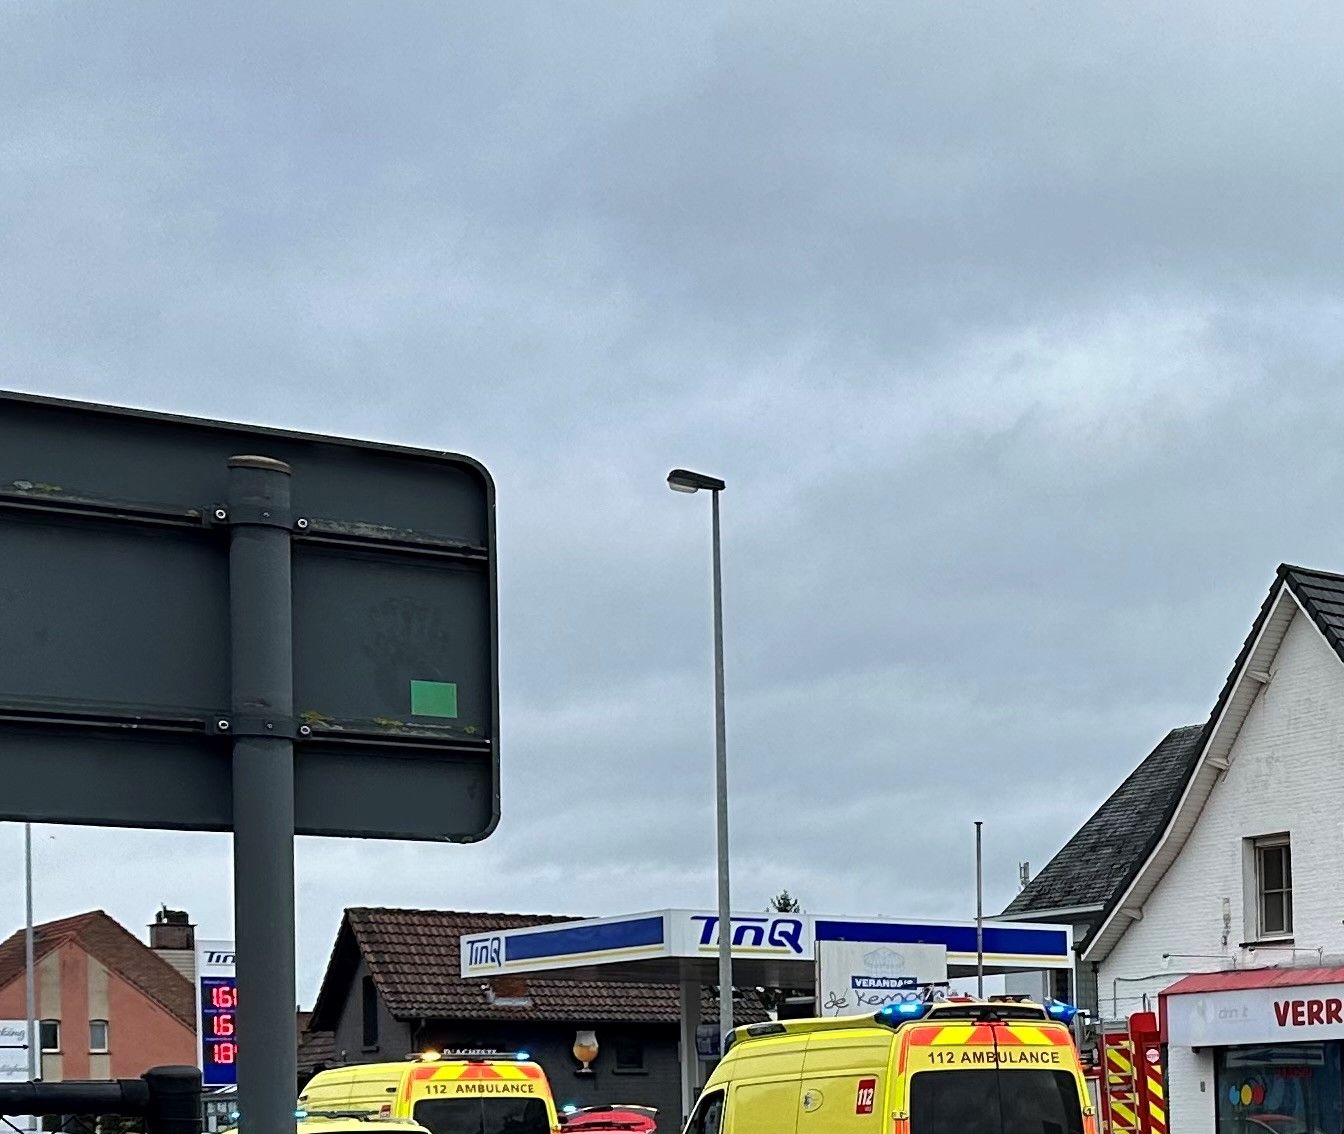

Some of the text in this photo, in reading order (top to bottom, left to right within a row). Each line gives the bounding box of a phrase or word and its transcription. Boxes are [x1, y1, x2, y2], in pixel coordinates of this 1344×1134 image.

[927, 1051, 1060, 1064] 112 AMBULANCE
[425, 1084, 534, 1094] 112 AMBULANCE
[858, 1088, 874, 1106] 112
